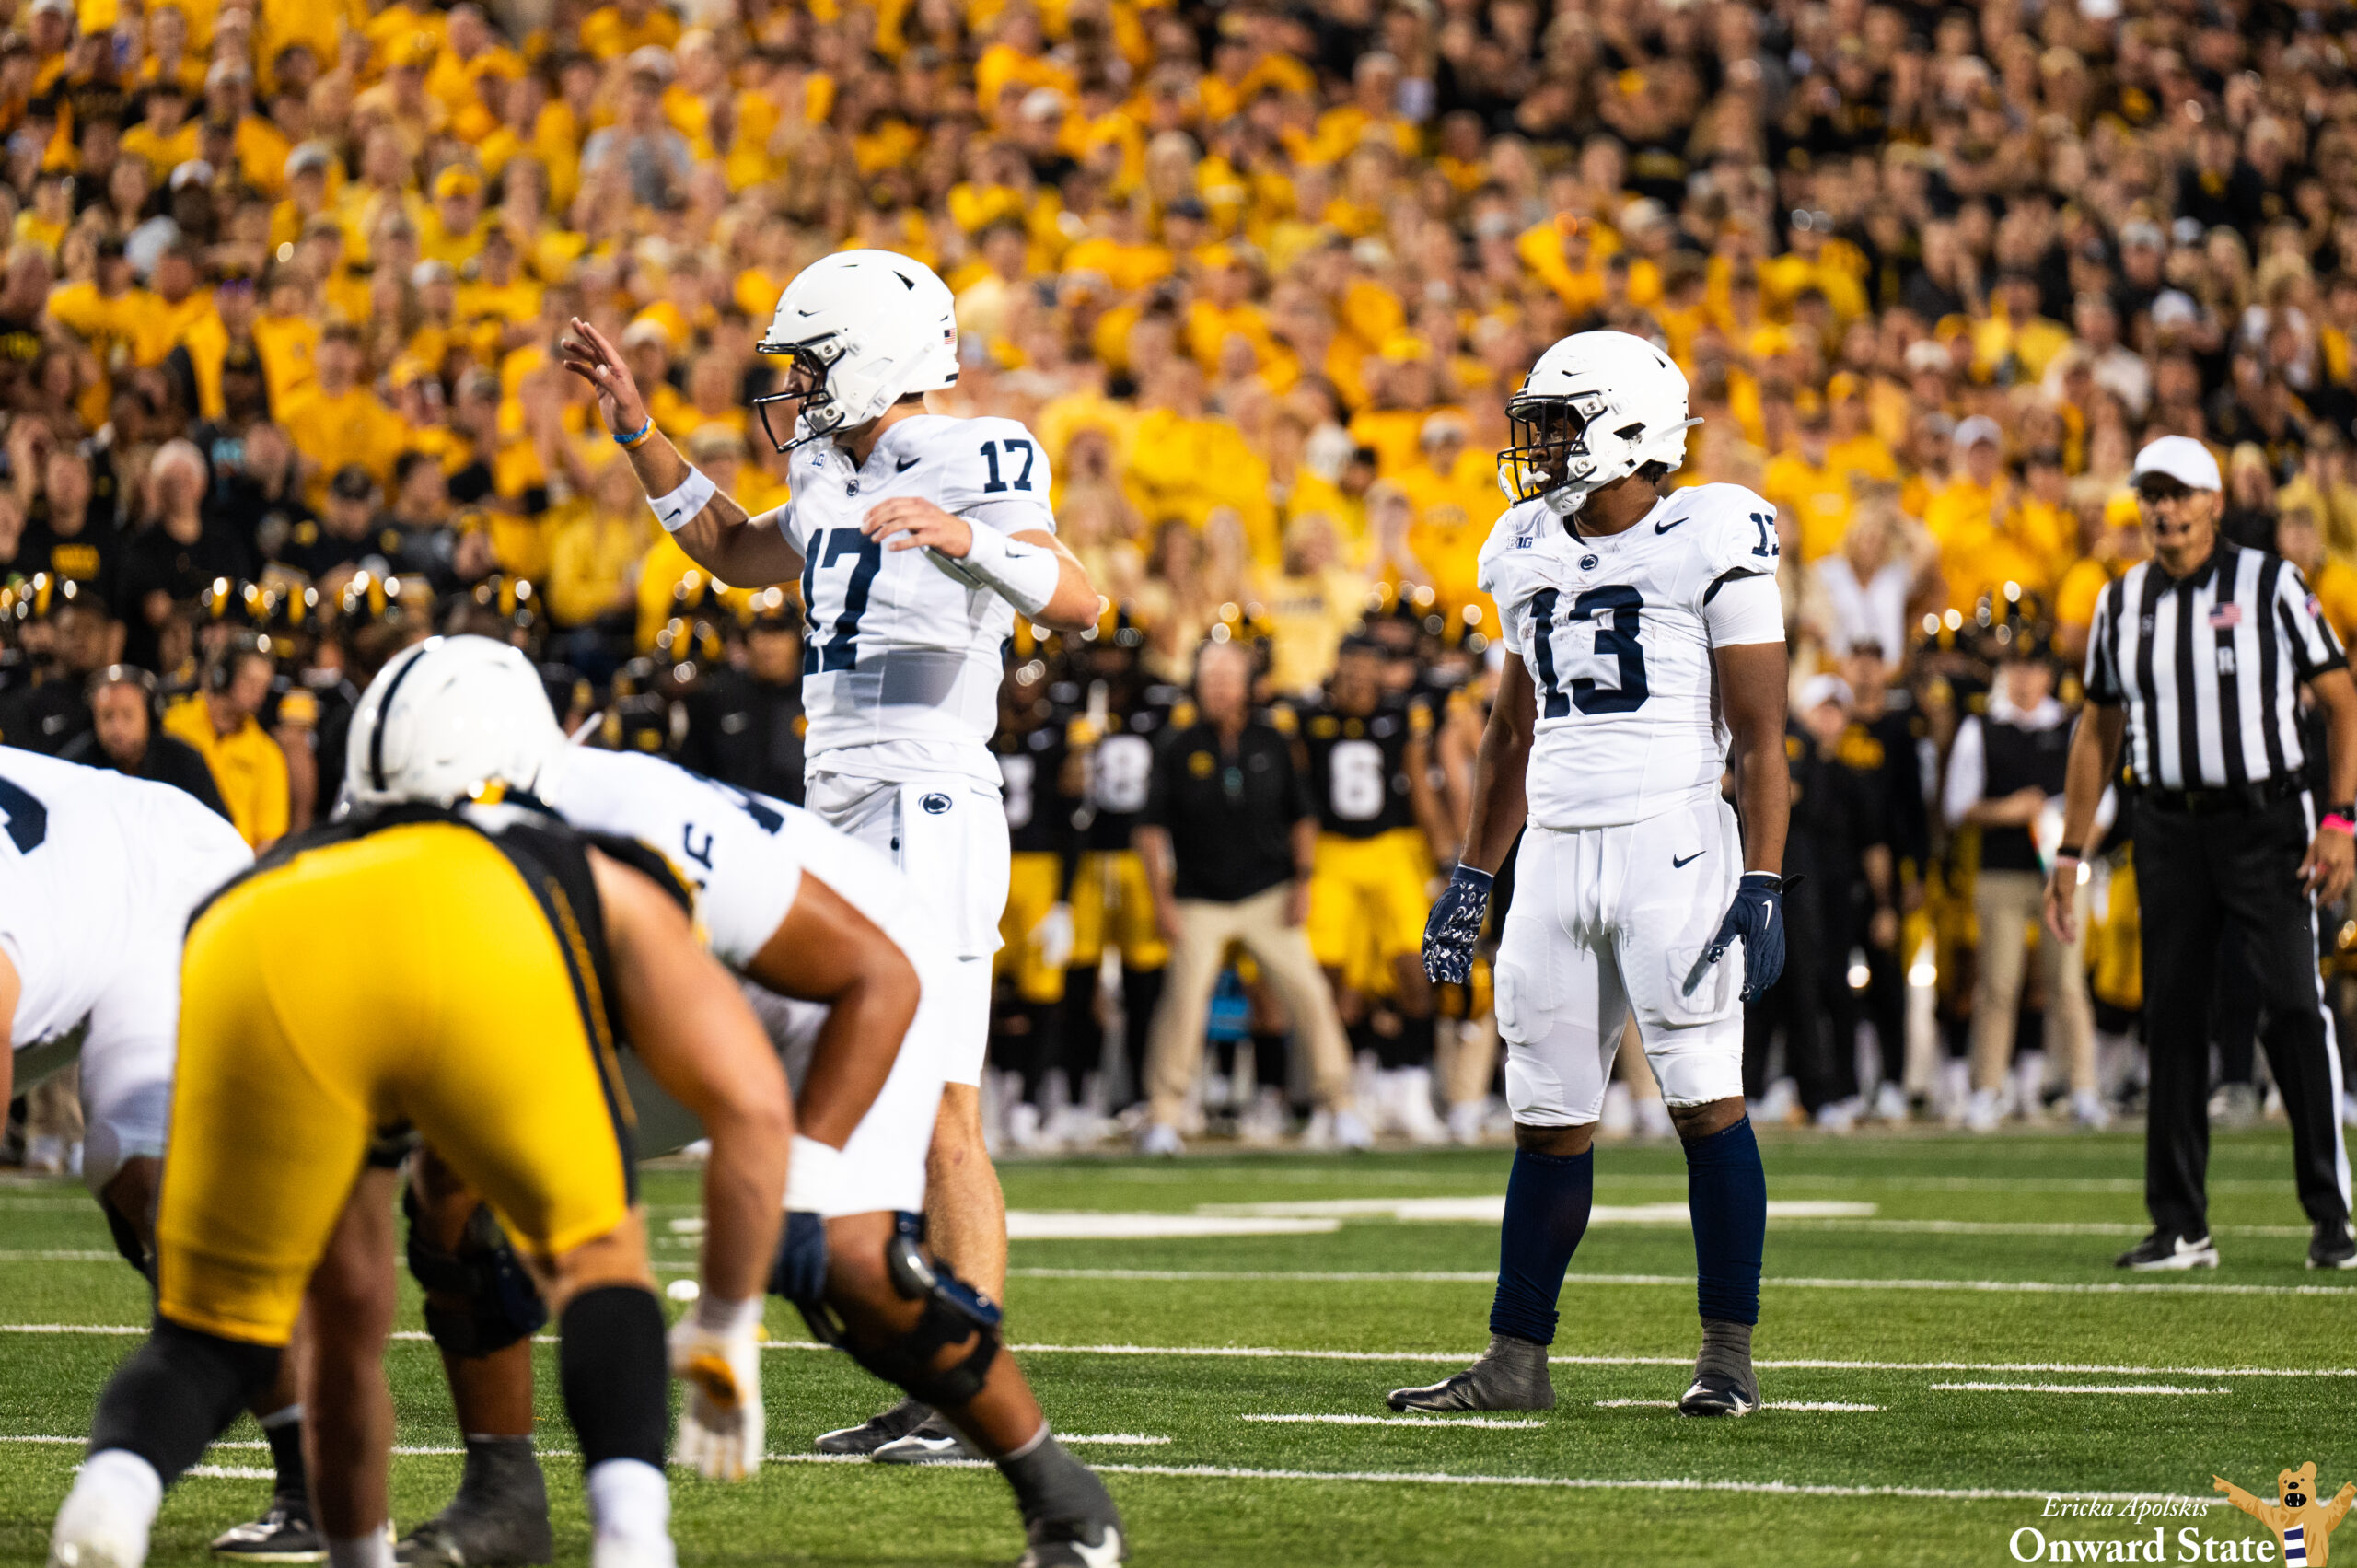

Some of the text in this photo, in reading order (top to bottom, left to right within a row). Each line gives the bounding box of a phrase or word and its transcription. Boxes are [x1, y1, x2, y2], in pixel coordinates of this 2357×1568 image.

[980, 438, 1034, 494] 17
[803, 527, 881, 676] 17
[1529, 584, 1650, 719] 13
[2216, 645, 2235, 676] R
[1329, 739, 1385, 821] 6
